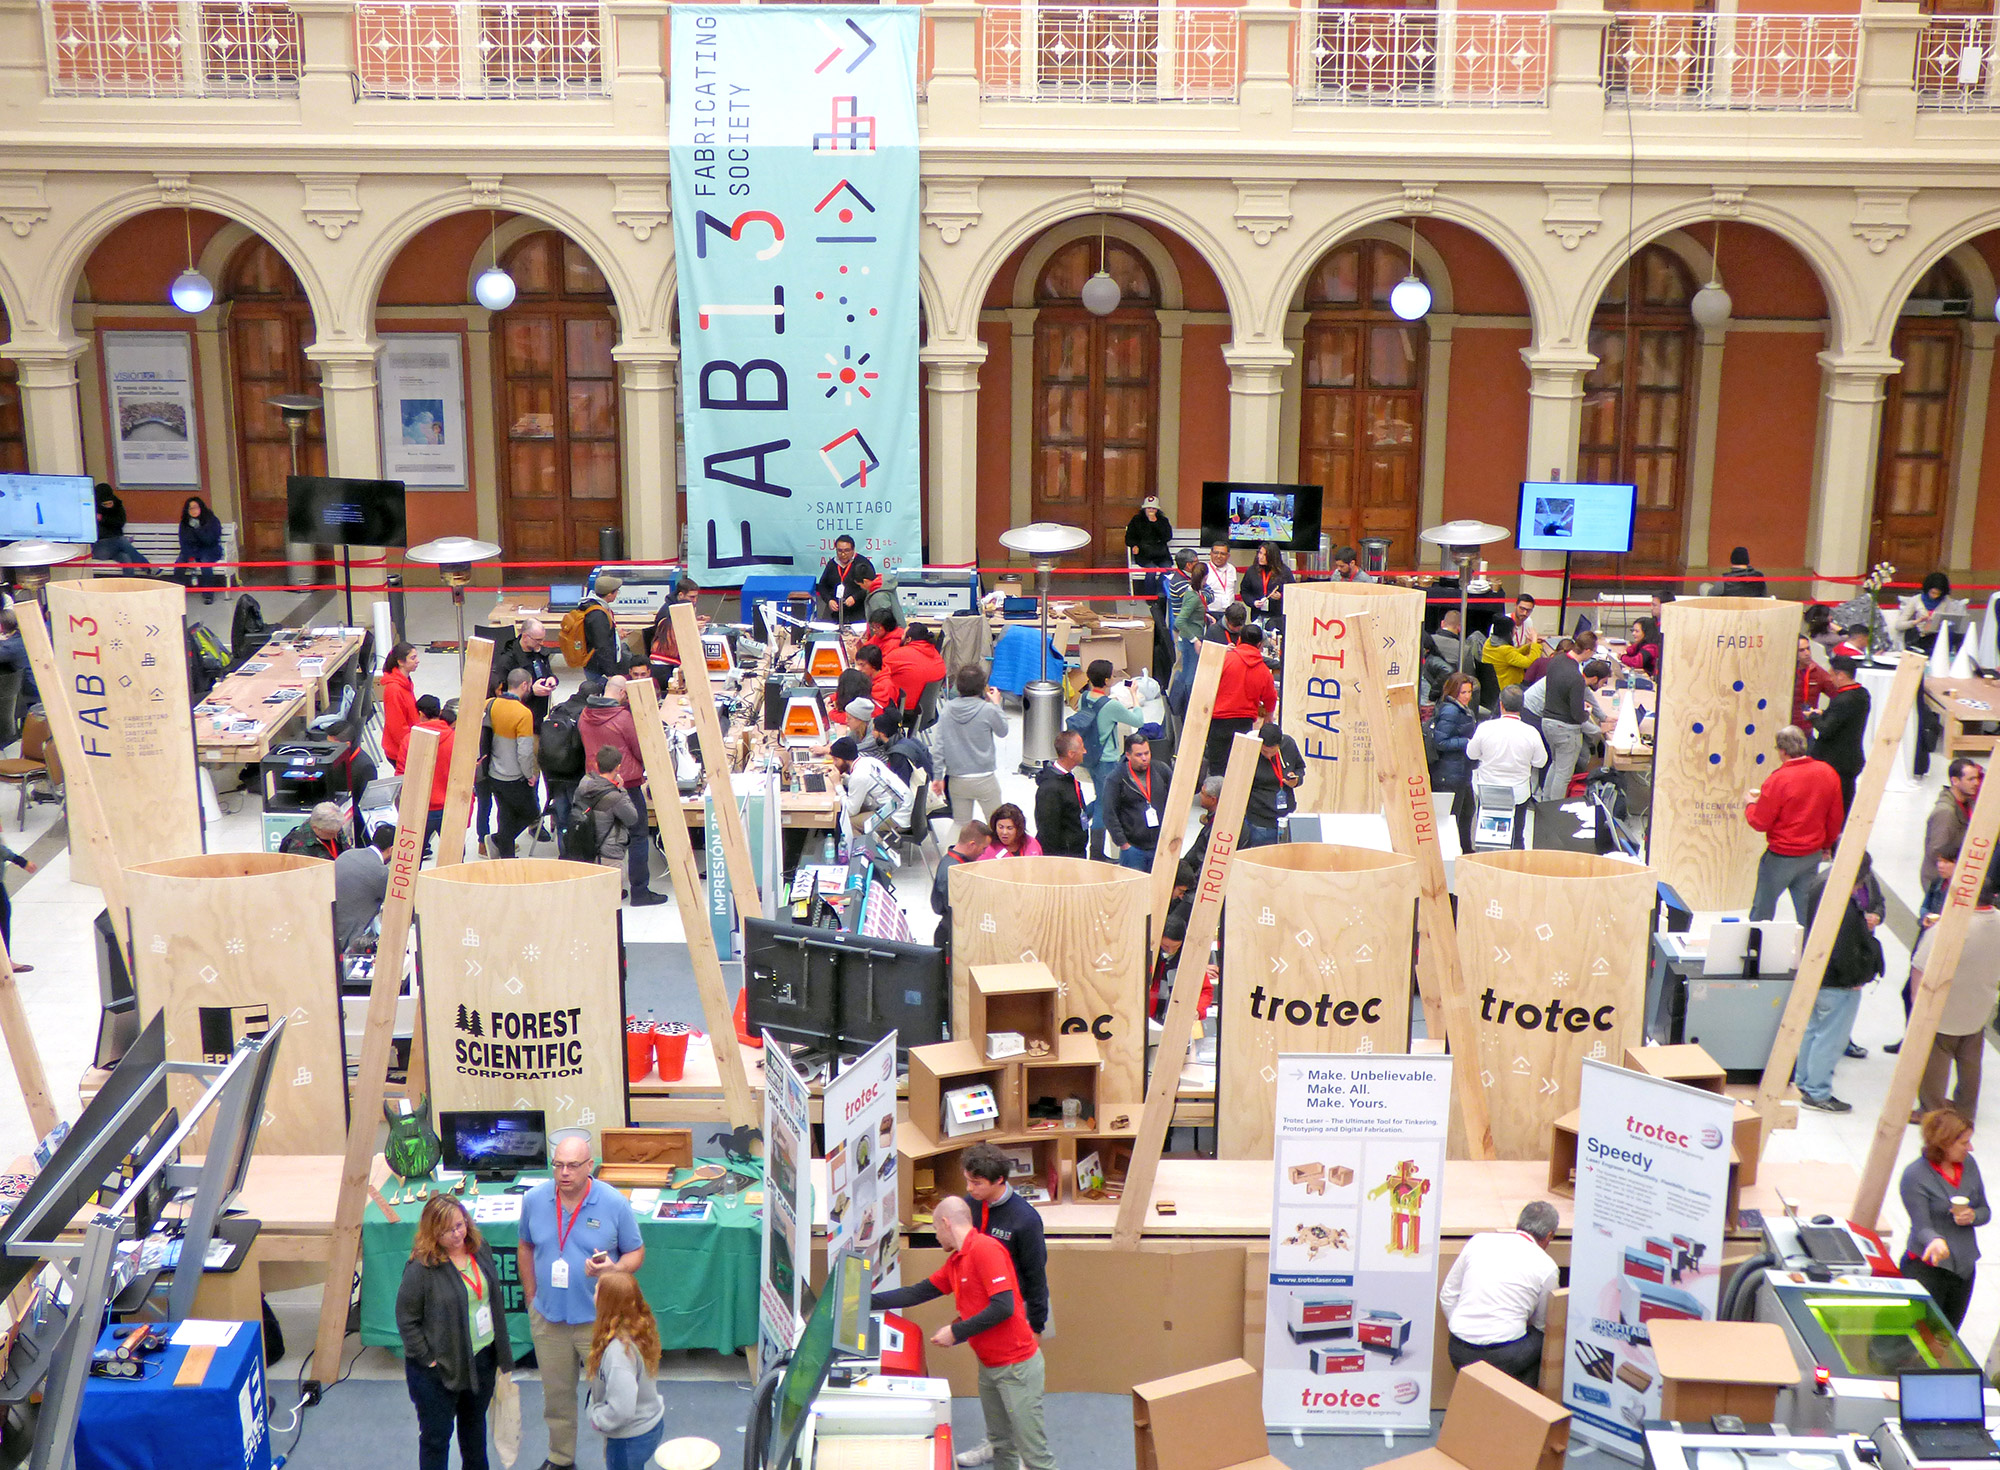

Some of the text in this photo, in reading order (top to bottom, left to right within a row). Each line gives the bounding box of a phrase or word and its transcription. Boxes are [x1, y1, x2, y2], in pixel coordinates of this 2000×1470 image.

[695, 16, 716, 196] FABRICATING
[729, 84, 751, 196] SOCIETY
[696, 210, 794, 571] FAB13
[817, 501, 892, 513] SANTIAGO
[817, 519, 863, 530] CHILE
[884, 557, 902, 568] 6th
[1717, 636, 1764, 648] FAB13
[69, 614, 111, 758] FAB13
[1305, 617, 1346, 761] FAB13
[1408, 775, 1432, 845] TROTEC
[391, 825, 417, 900] FOREST
[709, 834, 726, 915] IMPRESIÓN
[1201, 831, 1234, 903] TROTEC
[1952, 837, 1990, 907] TROTEC
[491, 1008, 580, 1039] FOREST
[1250, 986, 1382, 1027] trotec
[1480, 988, 1614, 1033] trotec
[455, 1038, 582, 1069] SCIENTIFIC
[456, 1066, 582, 1080] CORPORATION
[1307, 1084, 1370, 1095] Make. All.
[1308, 1070, 1436, 1082] Make. Unbelievable.
[845, 1083, 878, 1120] trotec
[1307, 1098, 1387, 1109] Make. Yours.
[1626, 1116, 1689, 1148] trotec
[1588, 1137, 1653, 1172] Speedy
[1302, 1389, 1380, 1407] trotec
